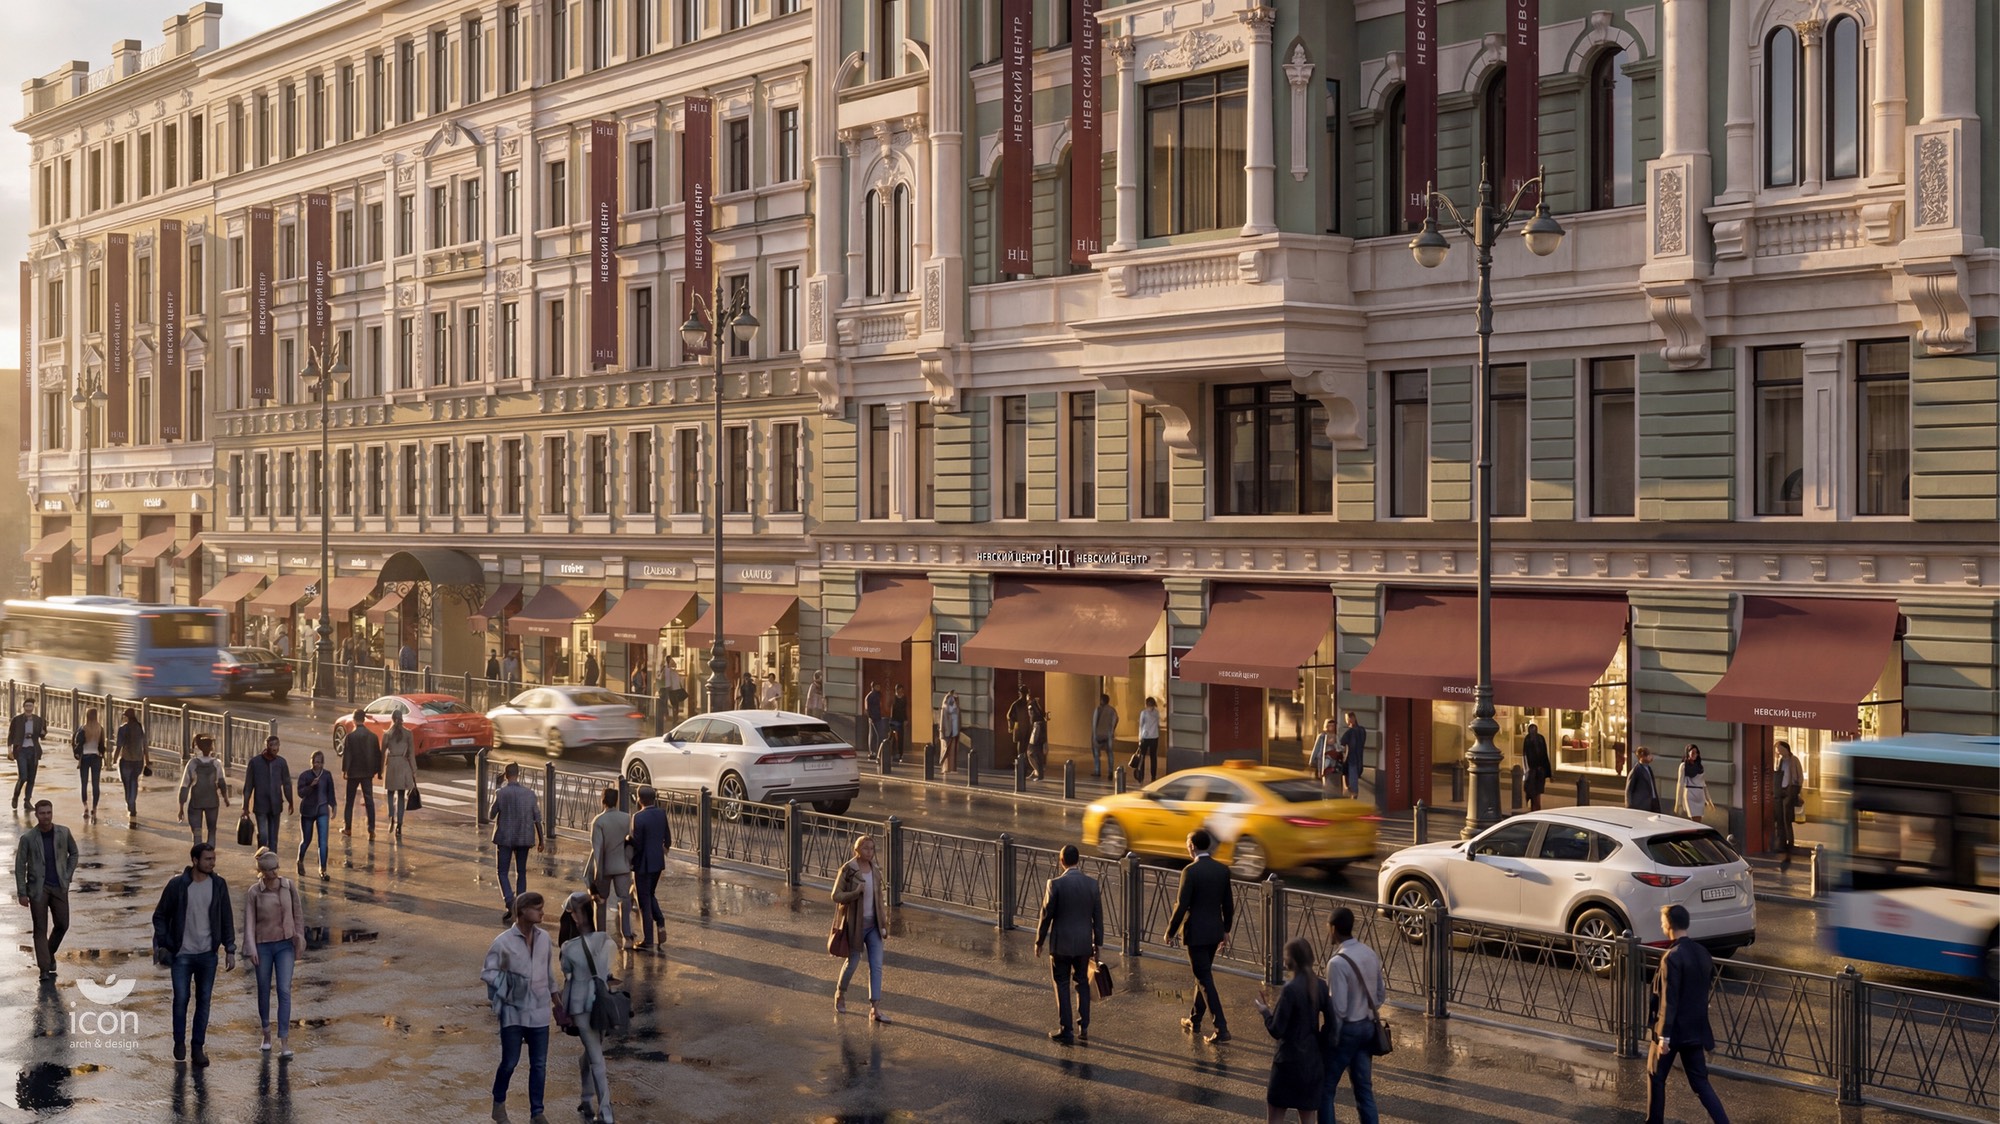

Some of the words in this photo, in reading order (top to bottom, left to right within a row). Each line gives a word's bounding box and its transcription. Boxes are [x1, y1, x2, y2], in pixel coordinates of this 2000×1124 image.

[1013, 16, 1025, 66] ЦЕНТР
[1082, 0, 1095, 49] ЦЕНТР
[1011, 71, 1023, 142] НЕВСКИЙ
[1080, 55, 1093, 130] НЕВСКИЙ
[601, 201, 609, 233] ЦЕНТР
[695, 182, 704, 217] ЦЕНТР
[600, 237, 609, 282] НЕВСКИЙ
[694, 219, 703, 269] НЕВСКИЙ
[316, 260, 324, 286] ЦЕНТР
[114, 302, 122, 330] ЦЕНТР
[167, 291, 175, 321] ЦЕНТР
[258, 298, 266, 335] НЕВСКИЙ
[315, 288, 323, 327] НЕВСКИЙ
[113, 332, 121, 373] НЕВСКИЙ
[165, 323, 174, 366] НЕВСКИЙ
[976, 550, 1014, 562] НЕВСКИЙ
[1016, 553, 1041, 563] ЦЕНТР
[1076, 552, 1117, 564] НЕВСКИЙ
[1119, 554, 1148, 565] ЦЕНТР
[1442, 685, 1471, 694] НЕВСКИЙ
[1753, 707, 1790, 717] НЕВСКИЙ
[1791, 710, 1817, 719] ЦЕНТР
